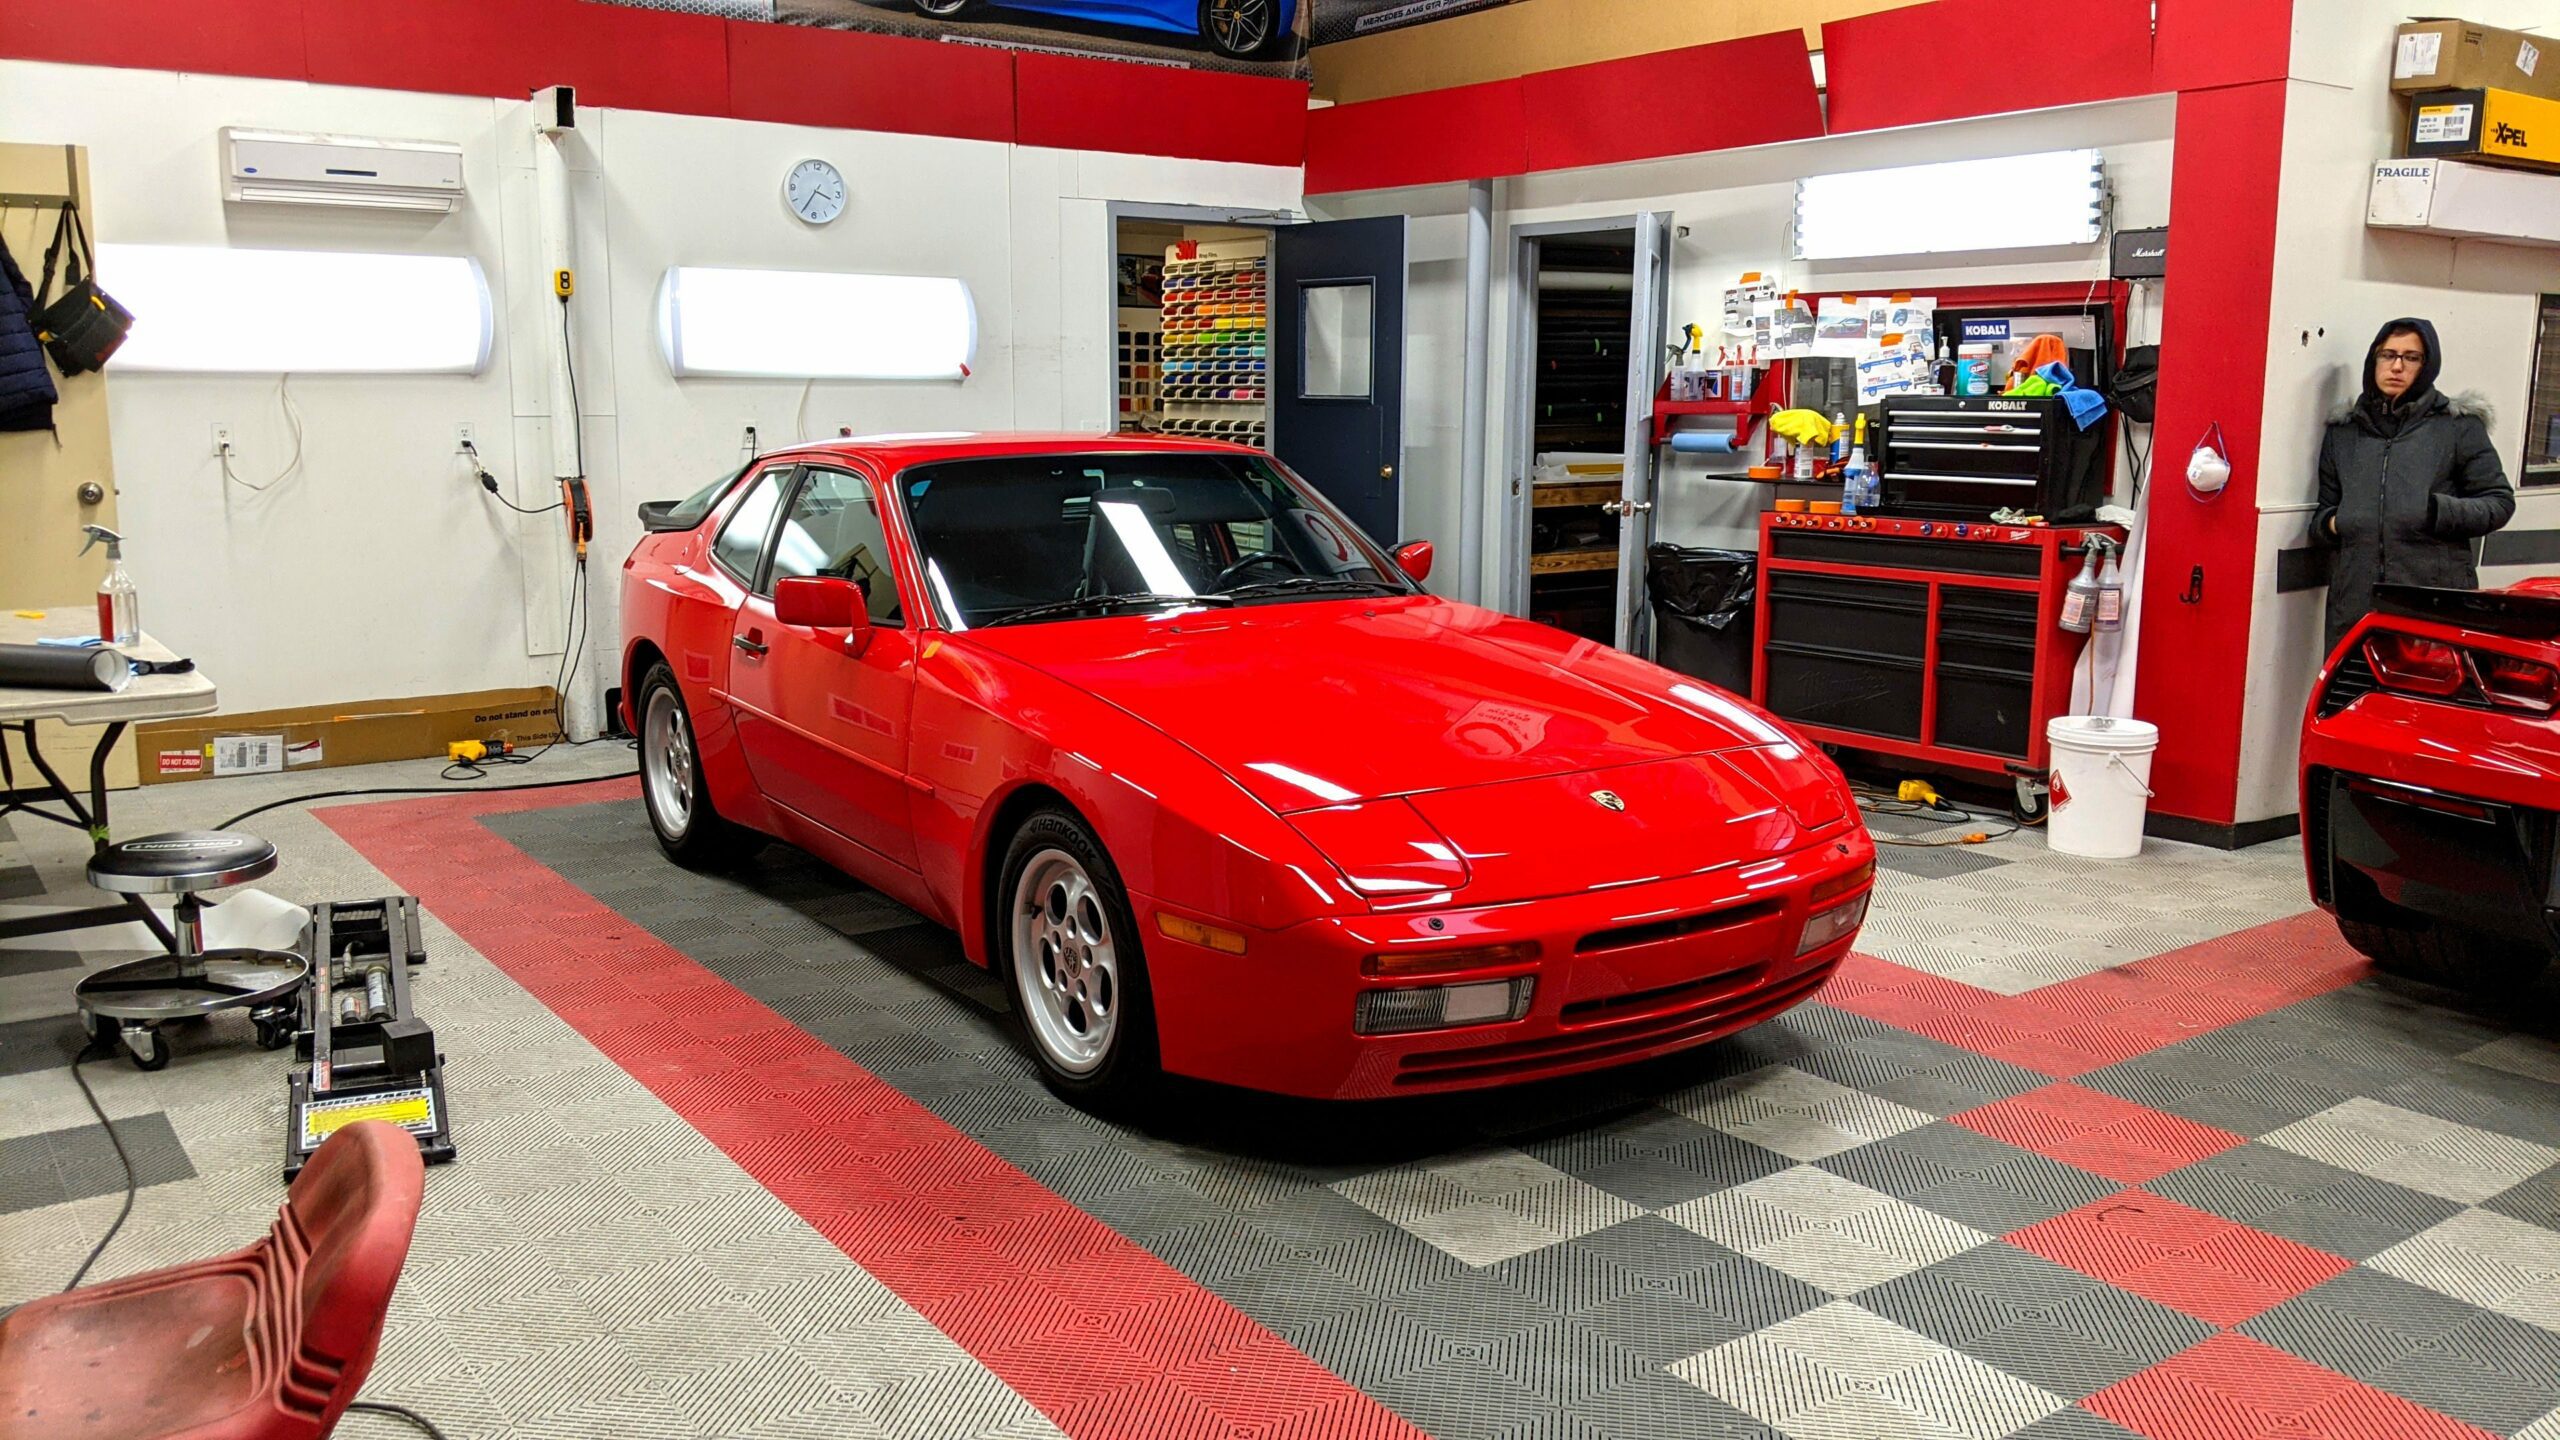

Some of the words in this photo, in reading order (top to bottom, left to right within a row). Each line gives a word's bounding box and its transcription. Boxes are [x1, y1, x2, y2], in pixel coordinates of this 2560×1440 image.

[1362, 10, 1403, 26] MERCEDES
[1405, 4, 1424, 16] AMG
[1425, 1, 1441, 11] GTR
[2494, 121, 2528, 148] XPEL
[813, 162, 822, 171] 12
[2376, 166, 2431, 178] FRAGILE
[790, 183, 796, 191] 9
[835, 190, 841, 199] 3
[811, 211, 817, 219] 6
[1175, 239, 1199, 261] 3M
[2131, 247, 2166, 258] Marshall
[1965, 324, 2007, 336] KOBALT
[1988, 400, 2028, 411] KOBALT
[475, 715, 487, 723] Do
[488, 713, 503, 721] not
[504, 710, 528, 720] stand
[530, 709, 541, 717] on
[516, 734, 531, 742] This
[532, 732, 547, 740] Side
[162, 758, 170, 766] DO
[171, 758, 181, 766] NOT
[182, 758, 200, 766] CRUSH
